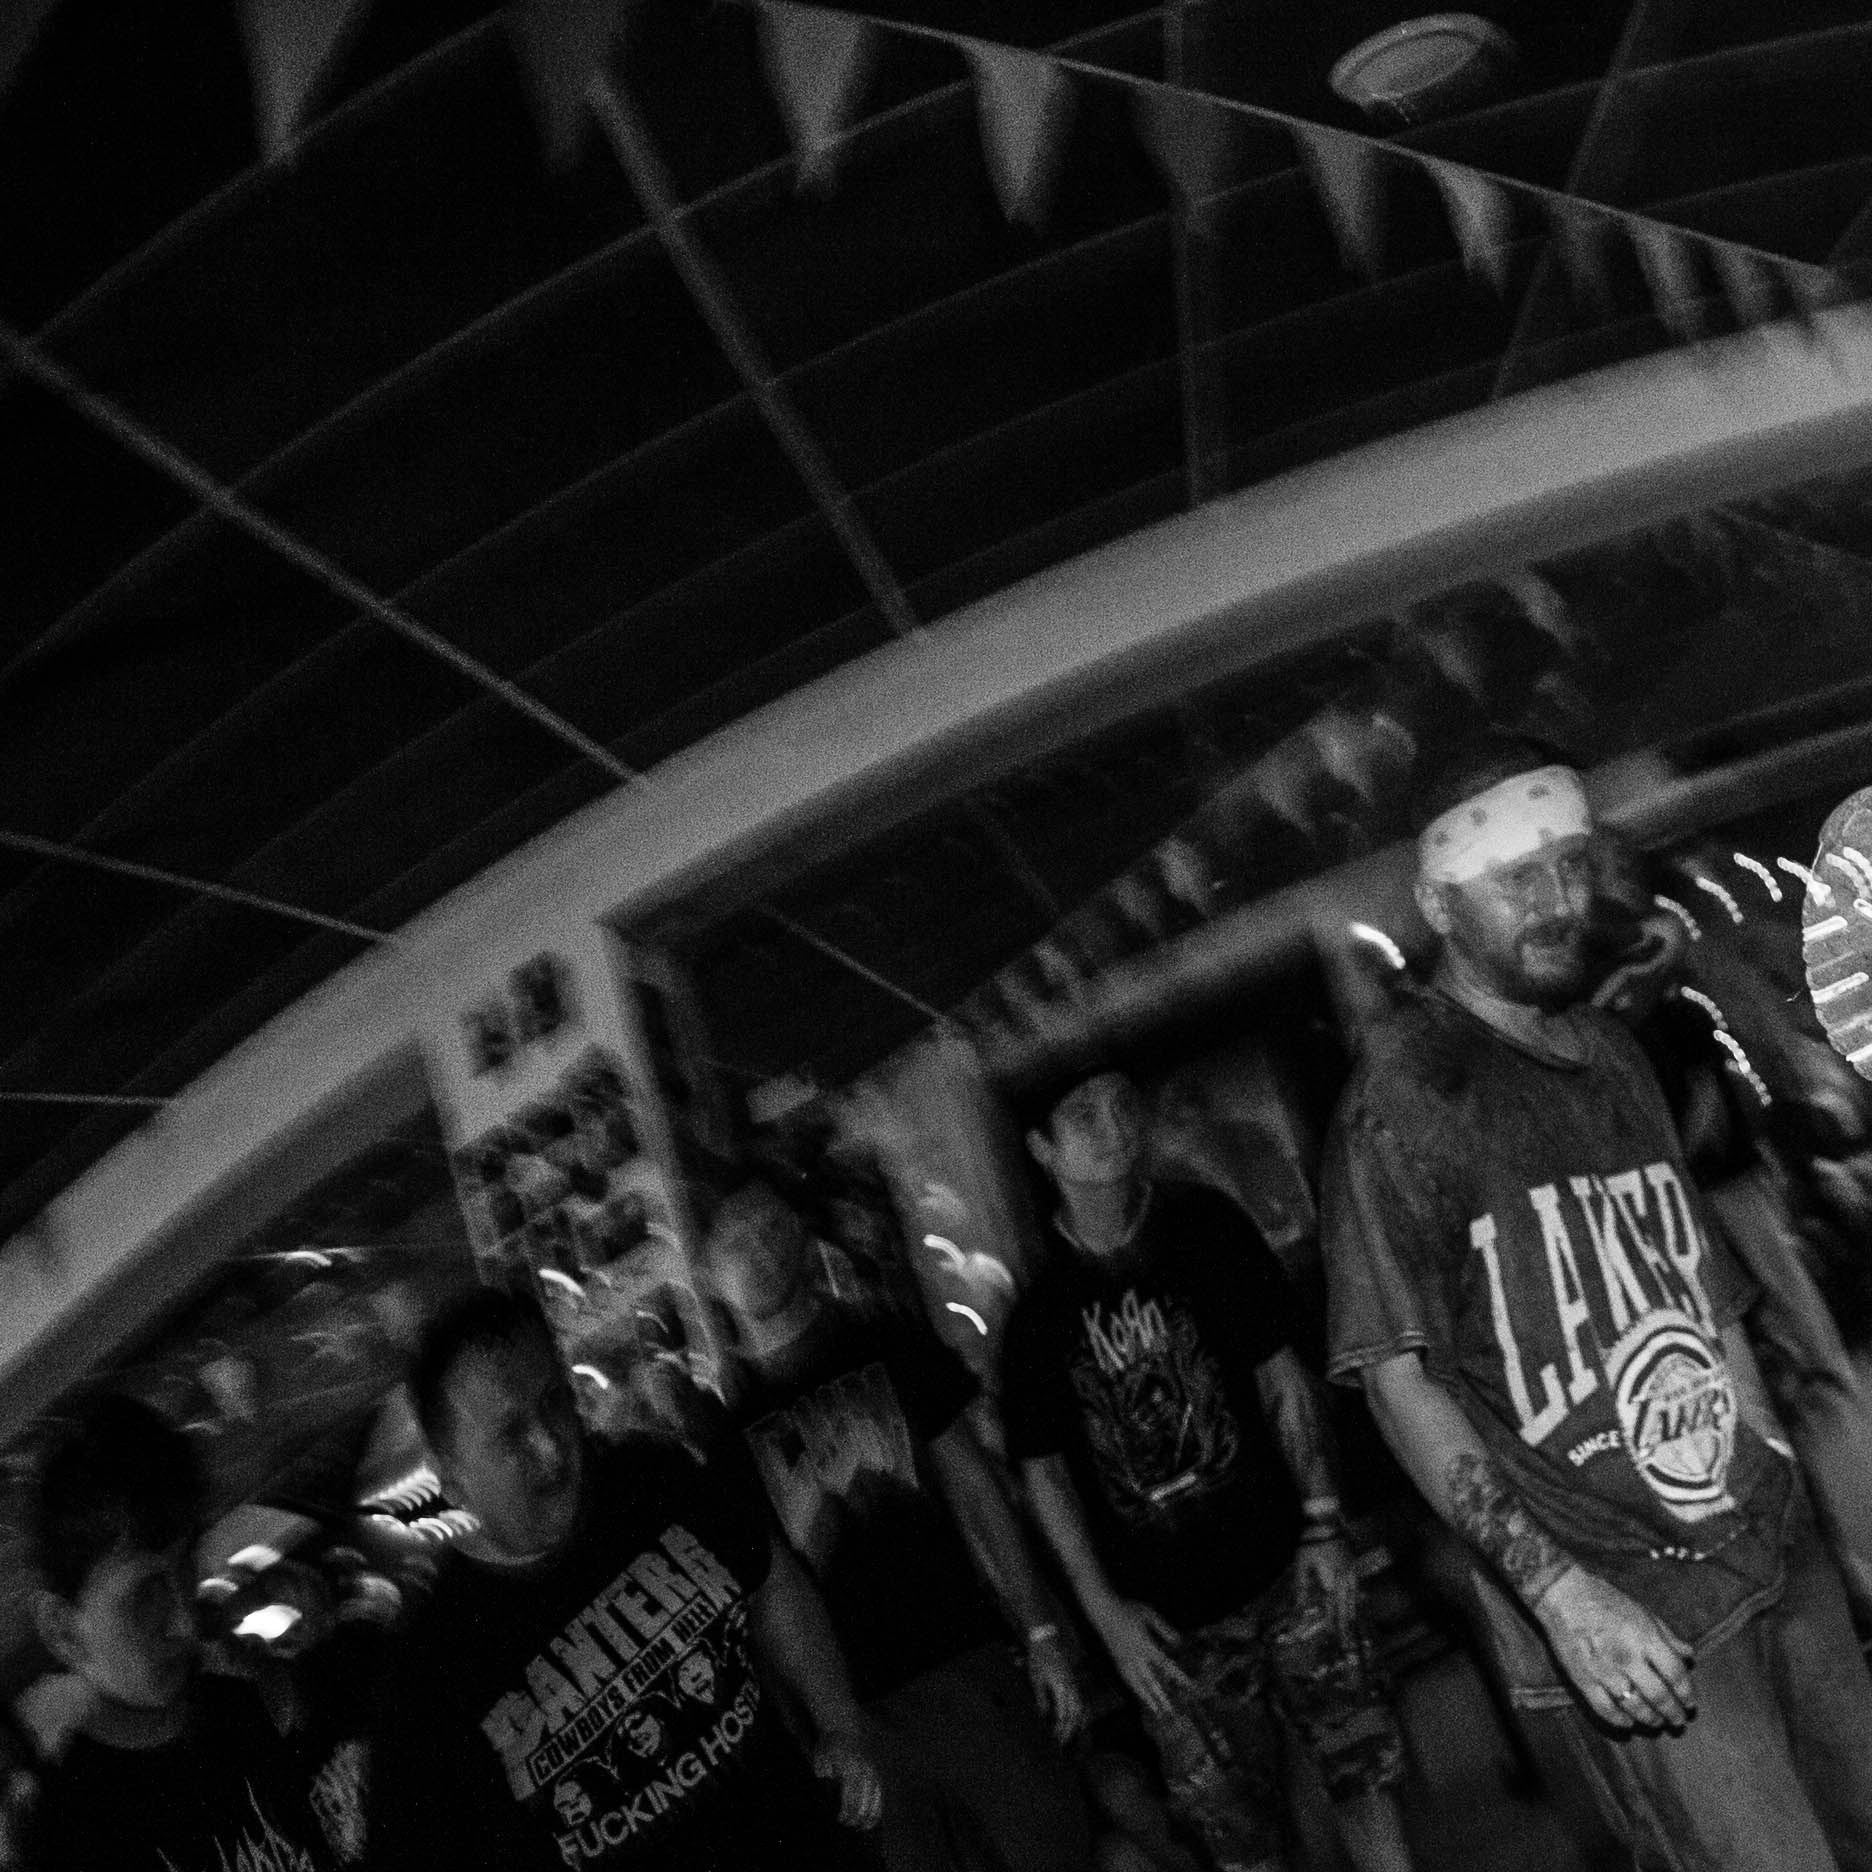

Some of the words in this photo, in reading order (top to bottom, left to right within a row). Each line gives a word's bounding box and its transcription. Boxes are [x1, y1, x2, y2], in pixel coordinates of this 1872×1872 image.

[1567, 1429, 1622, 1468] SINCE
[480, 1522, 744, 1802] PANTERA
[533, 1682, 627, 1780] COWBOYS
[621, 1634, 678, 1694] FROM
[553, 1751, 707, 1872] FUCKING
